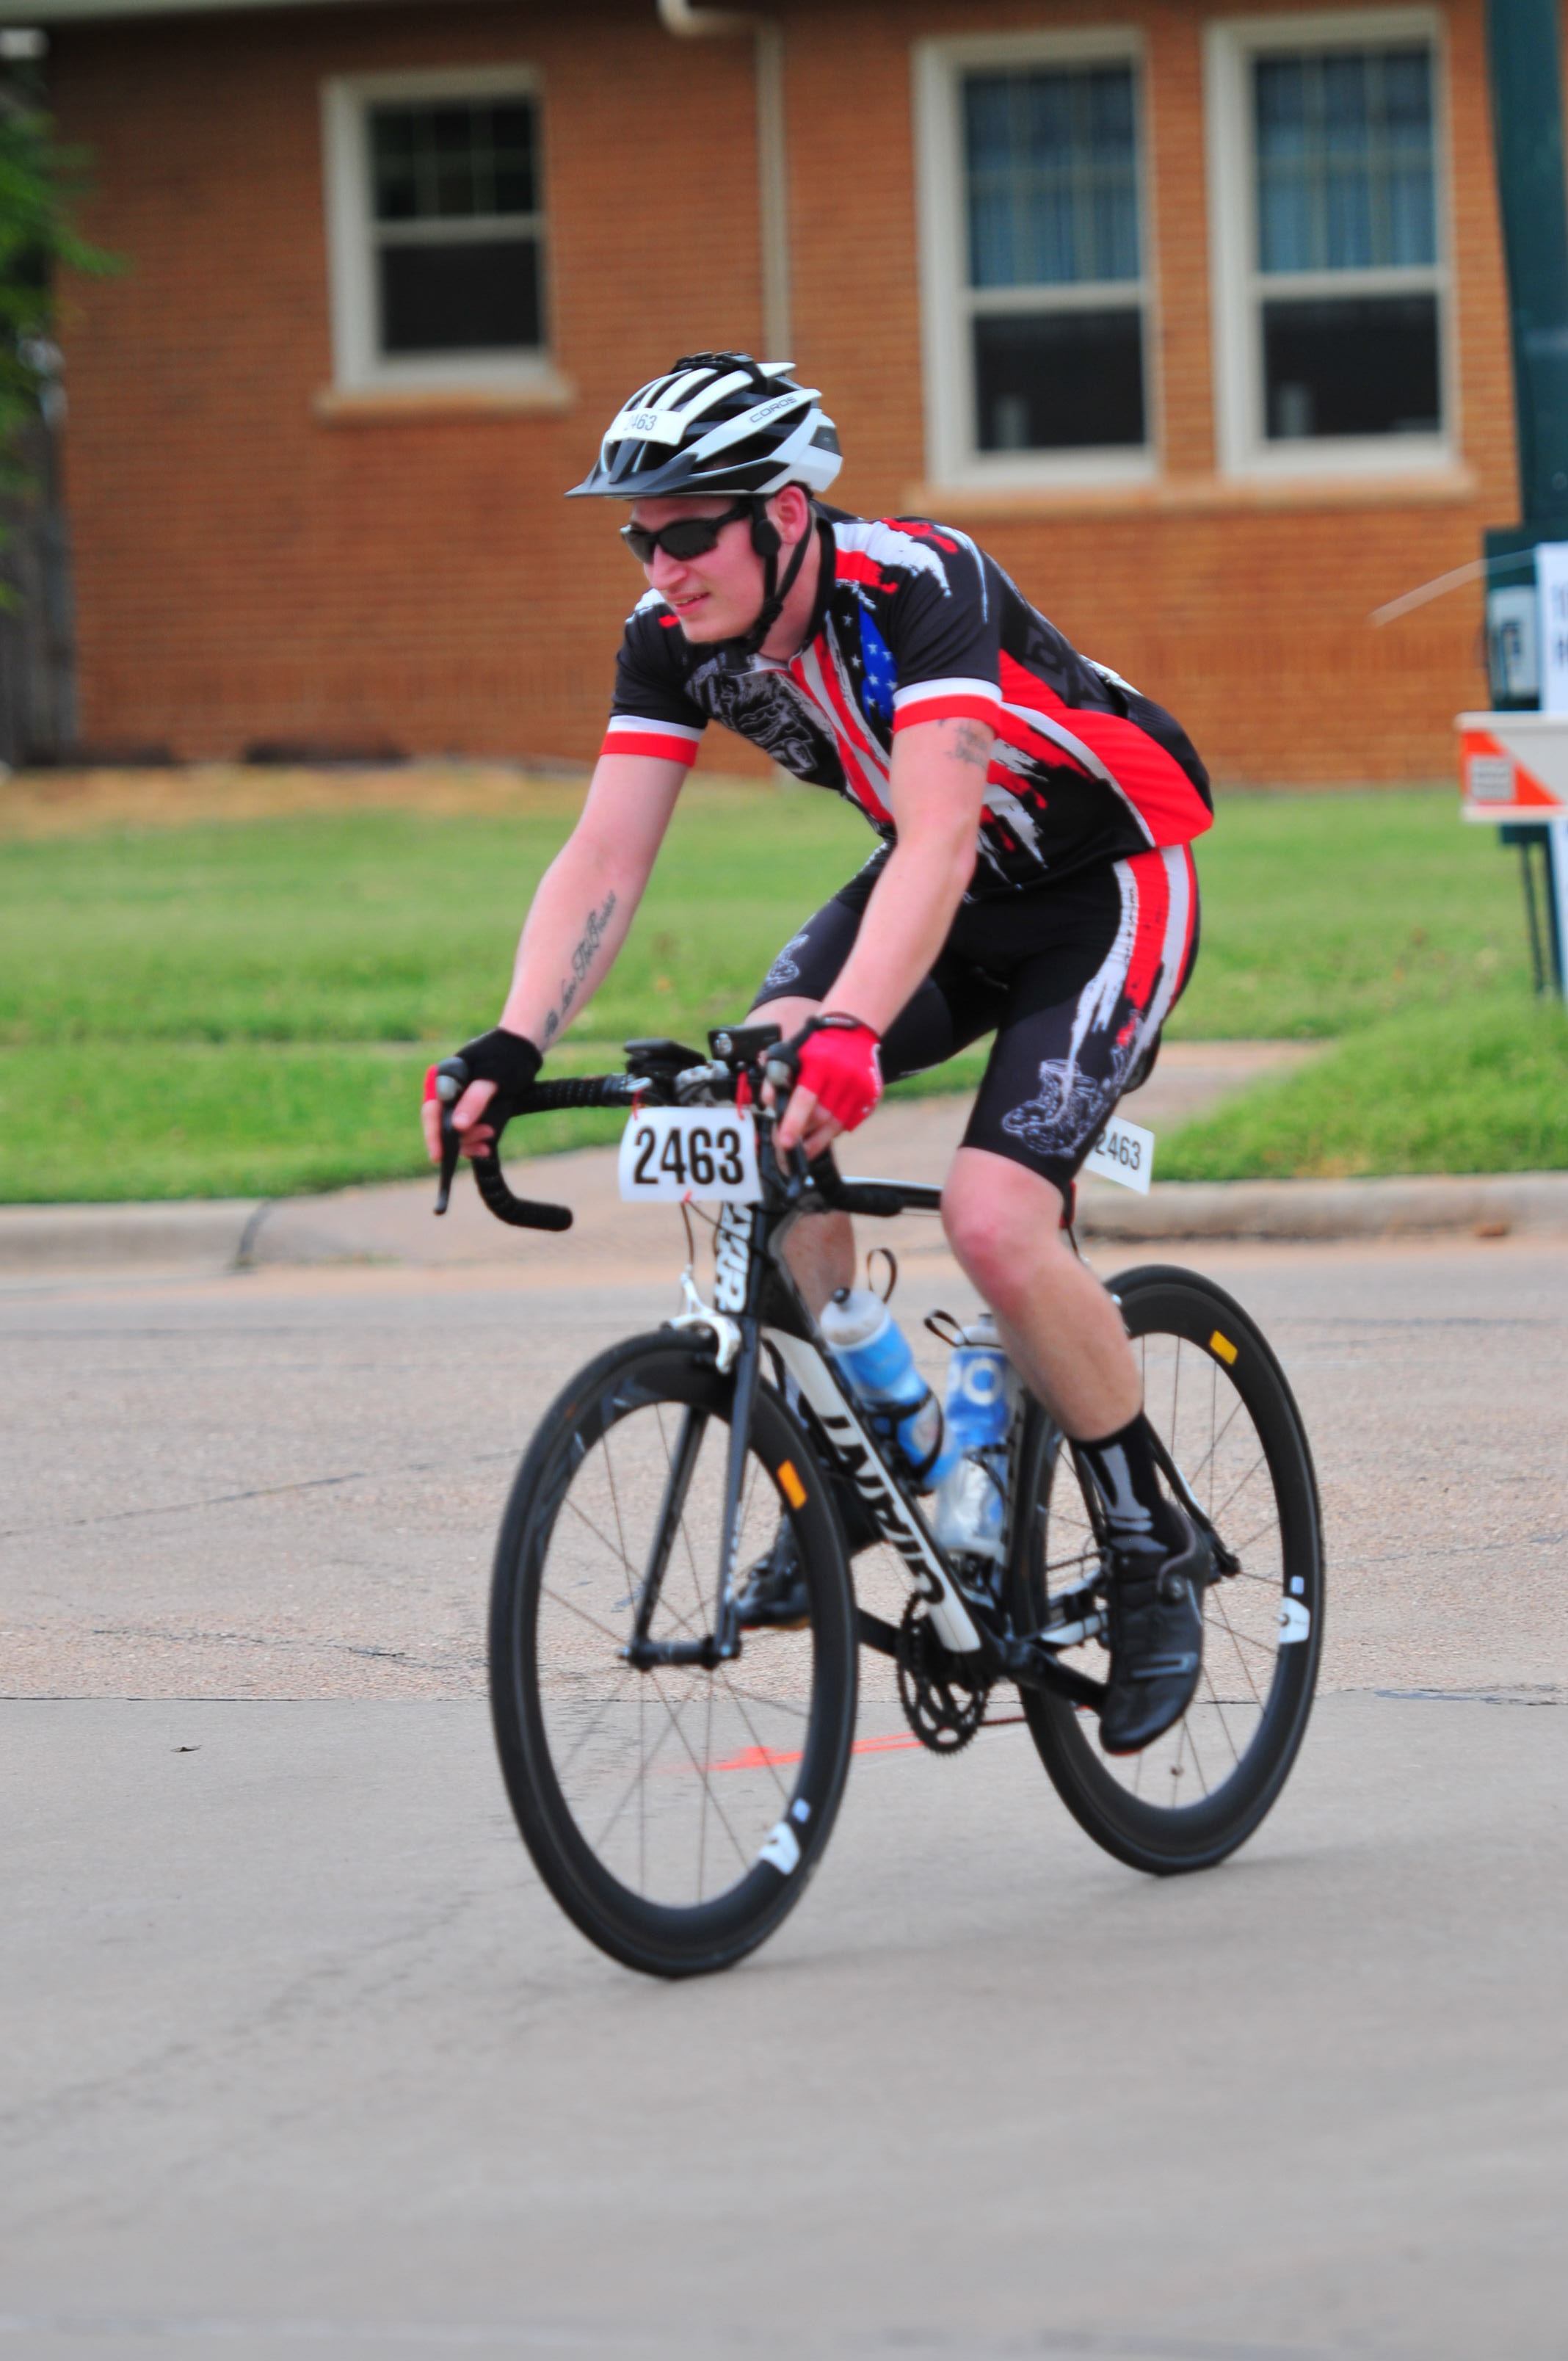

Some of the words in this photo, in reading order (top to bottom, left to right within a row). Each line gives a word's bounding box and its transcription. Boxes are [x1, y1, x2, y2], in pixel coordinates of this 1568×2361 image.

[749, 396, 798, 424] COROS
[634, 1125, 745, 1185] 2463
[1095, 1131, 1141, 1171] 2463
